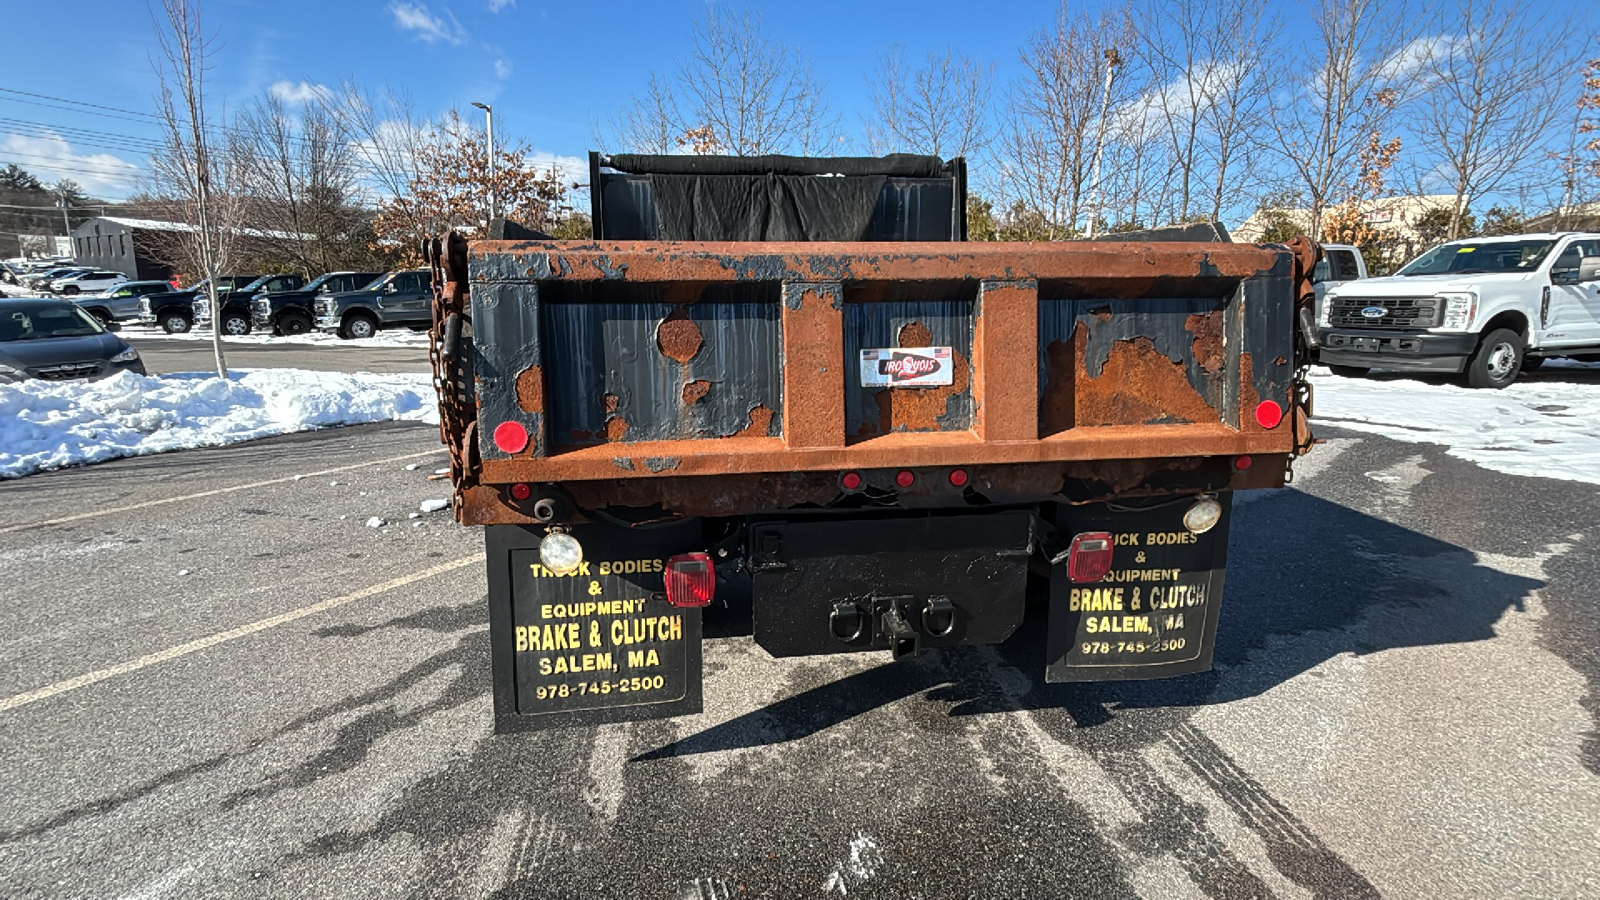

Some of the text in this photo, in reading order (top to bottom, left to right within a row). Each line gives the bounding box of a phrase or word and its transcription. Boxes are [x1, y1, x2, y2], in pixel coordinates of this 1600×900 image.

[884, 356, 935, 374] IROQUOIS
[1146, 532, 1197, 546] BODIES
[1135, 551, 1146, 563] &
[530, 559, 663, 578] TRK BODIES
[1104, 568, 1181, 582] QUIPMENT
[588, 580, 602, 595] &
[1069, 583, 1206, 611] BRAKE & CLUTCH
[541, 599, 646, 619] EQUIPMENT
[516, 615, 682, 652] BRAKE & CLUTCH
[1086, 616, 1153, 635] SALEM,
[1081, 637, 1186, 654] 978-745-2500
[539, 650, 660, 675] SALEM, MA
[536, 675, 664, 700] 978-745-2500
